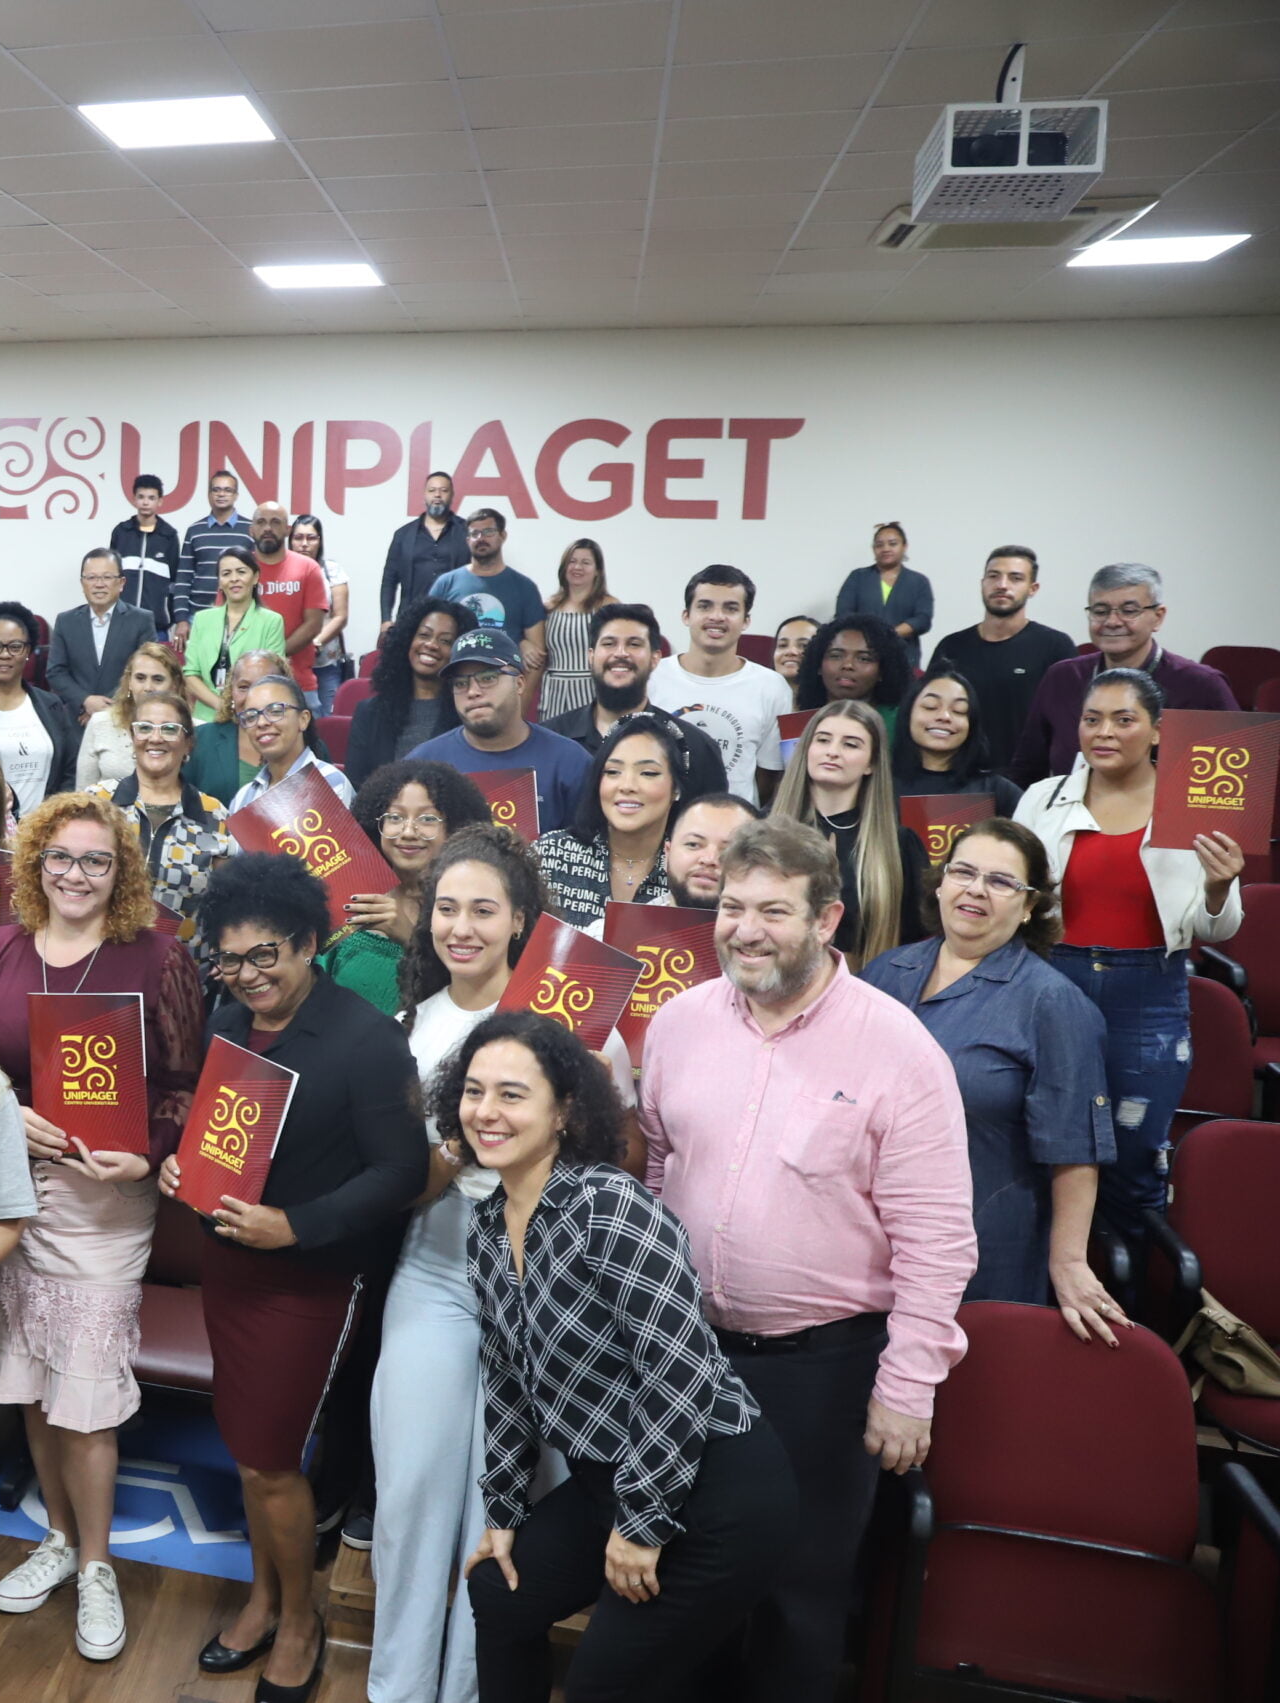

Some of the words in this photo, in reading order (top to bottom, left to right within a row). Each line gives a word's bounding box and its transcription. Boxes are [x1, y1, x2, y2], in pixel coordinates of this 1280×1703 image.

[120, 418, 806, 521] UNIPIAGET
[265, 581, 301, 596] Diego
[706, 704, 720, 715] THE
[721, 710, 744, 741] ORIGINAL
[9, 761, 41, 771] COFFEE
[1187, 796, 1245, 805] UNIPIAGET
[311, 849, 348, 877] IPIAGET
[541, 857, 568, 874] ANÇA
[547, 881, 600, 903] APERFUME
[639, 885, 669, 898] PERF
[63, 1091, 118, 1100] UNIPIAGET
[200, 1140, 245, 1170] UNIPIAGET
